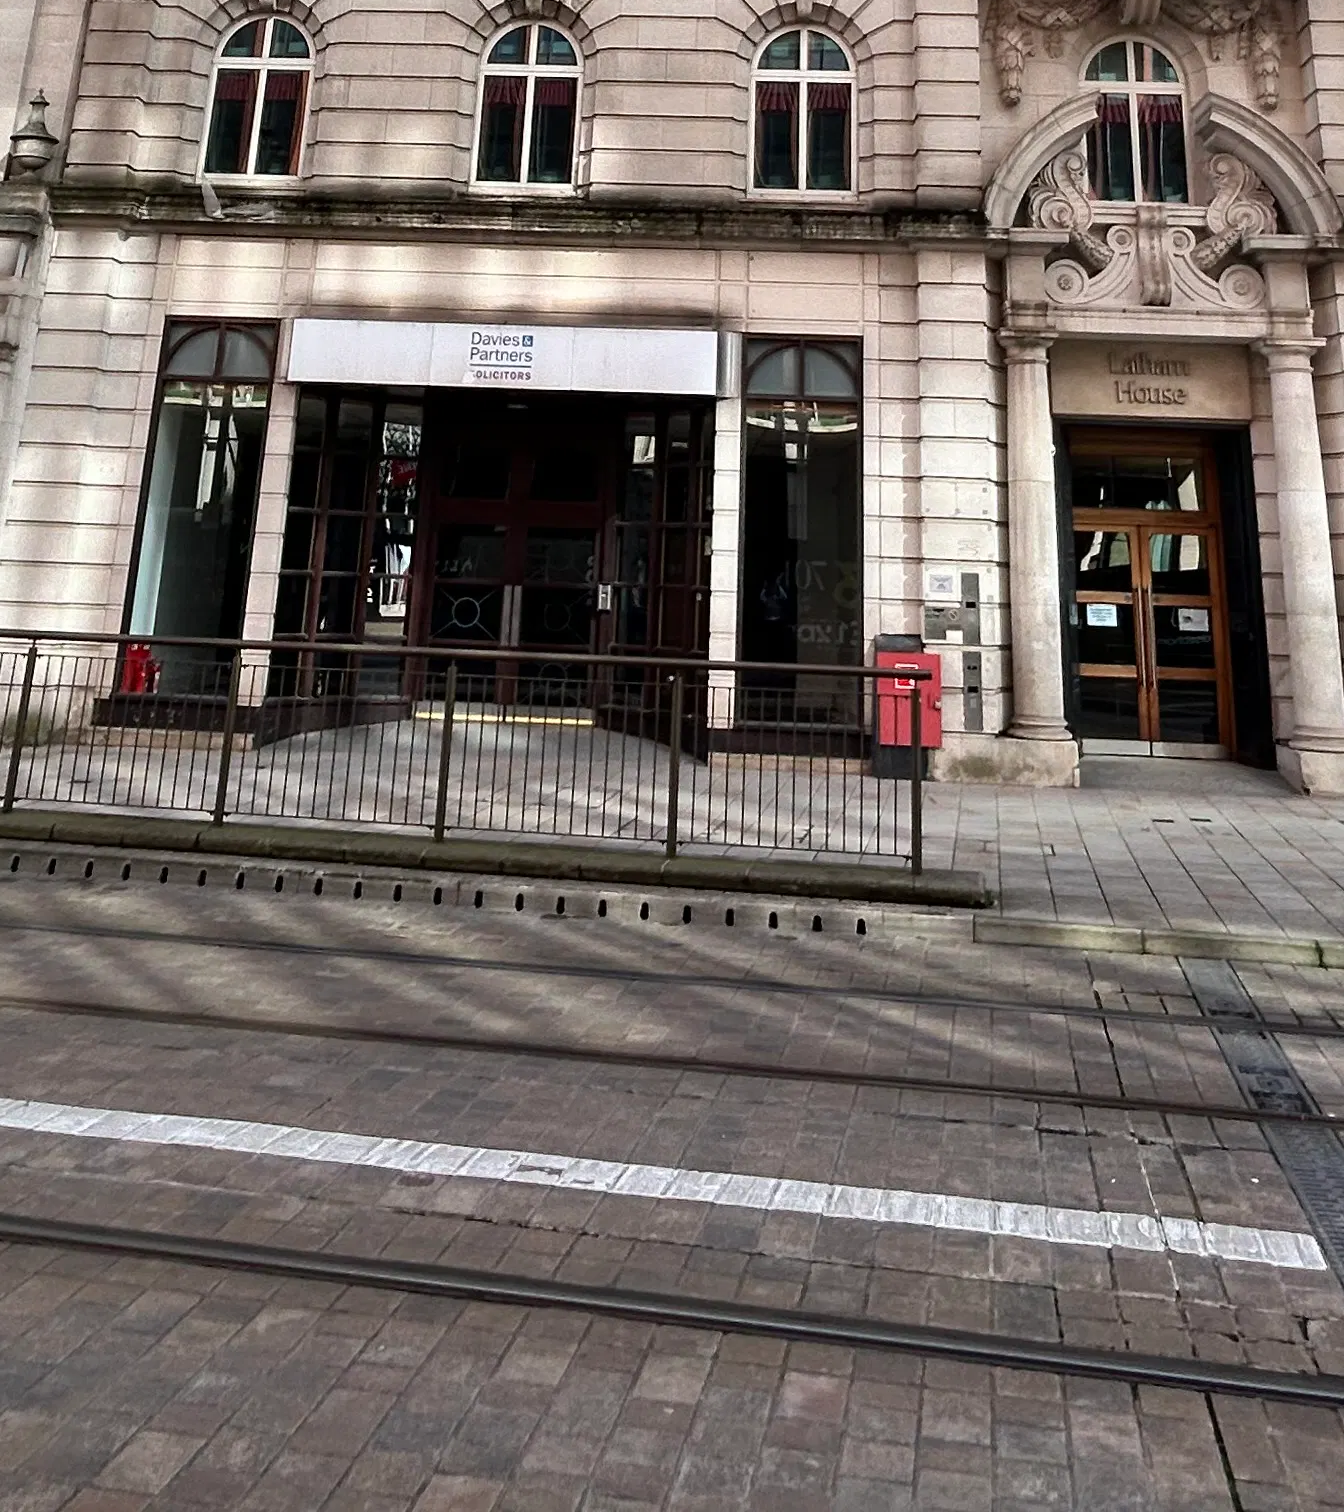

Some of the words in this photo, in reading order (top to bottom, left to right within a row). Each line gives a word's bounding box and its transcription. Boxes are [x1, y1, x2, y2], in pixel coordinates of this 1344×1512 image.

[471, 331, 520, 346] Davies
[469, 346, 533, 363] Partners
[1106, 351, 1192, 377] Latham
[471, 370, 532, 381] OLICITORS
[1114, 379, 1188, 405] House
